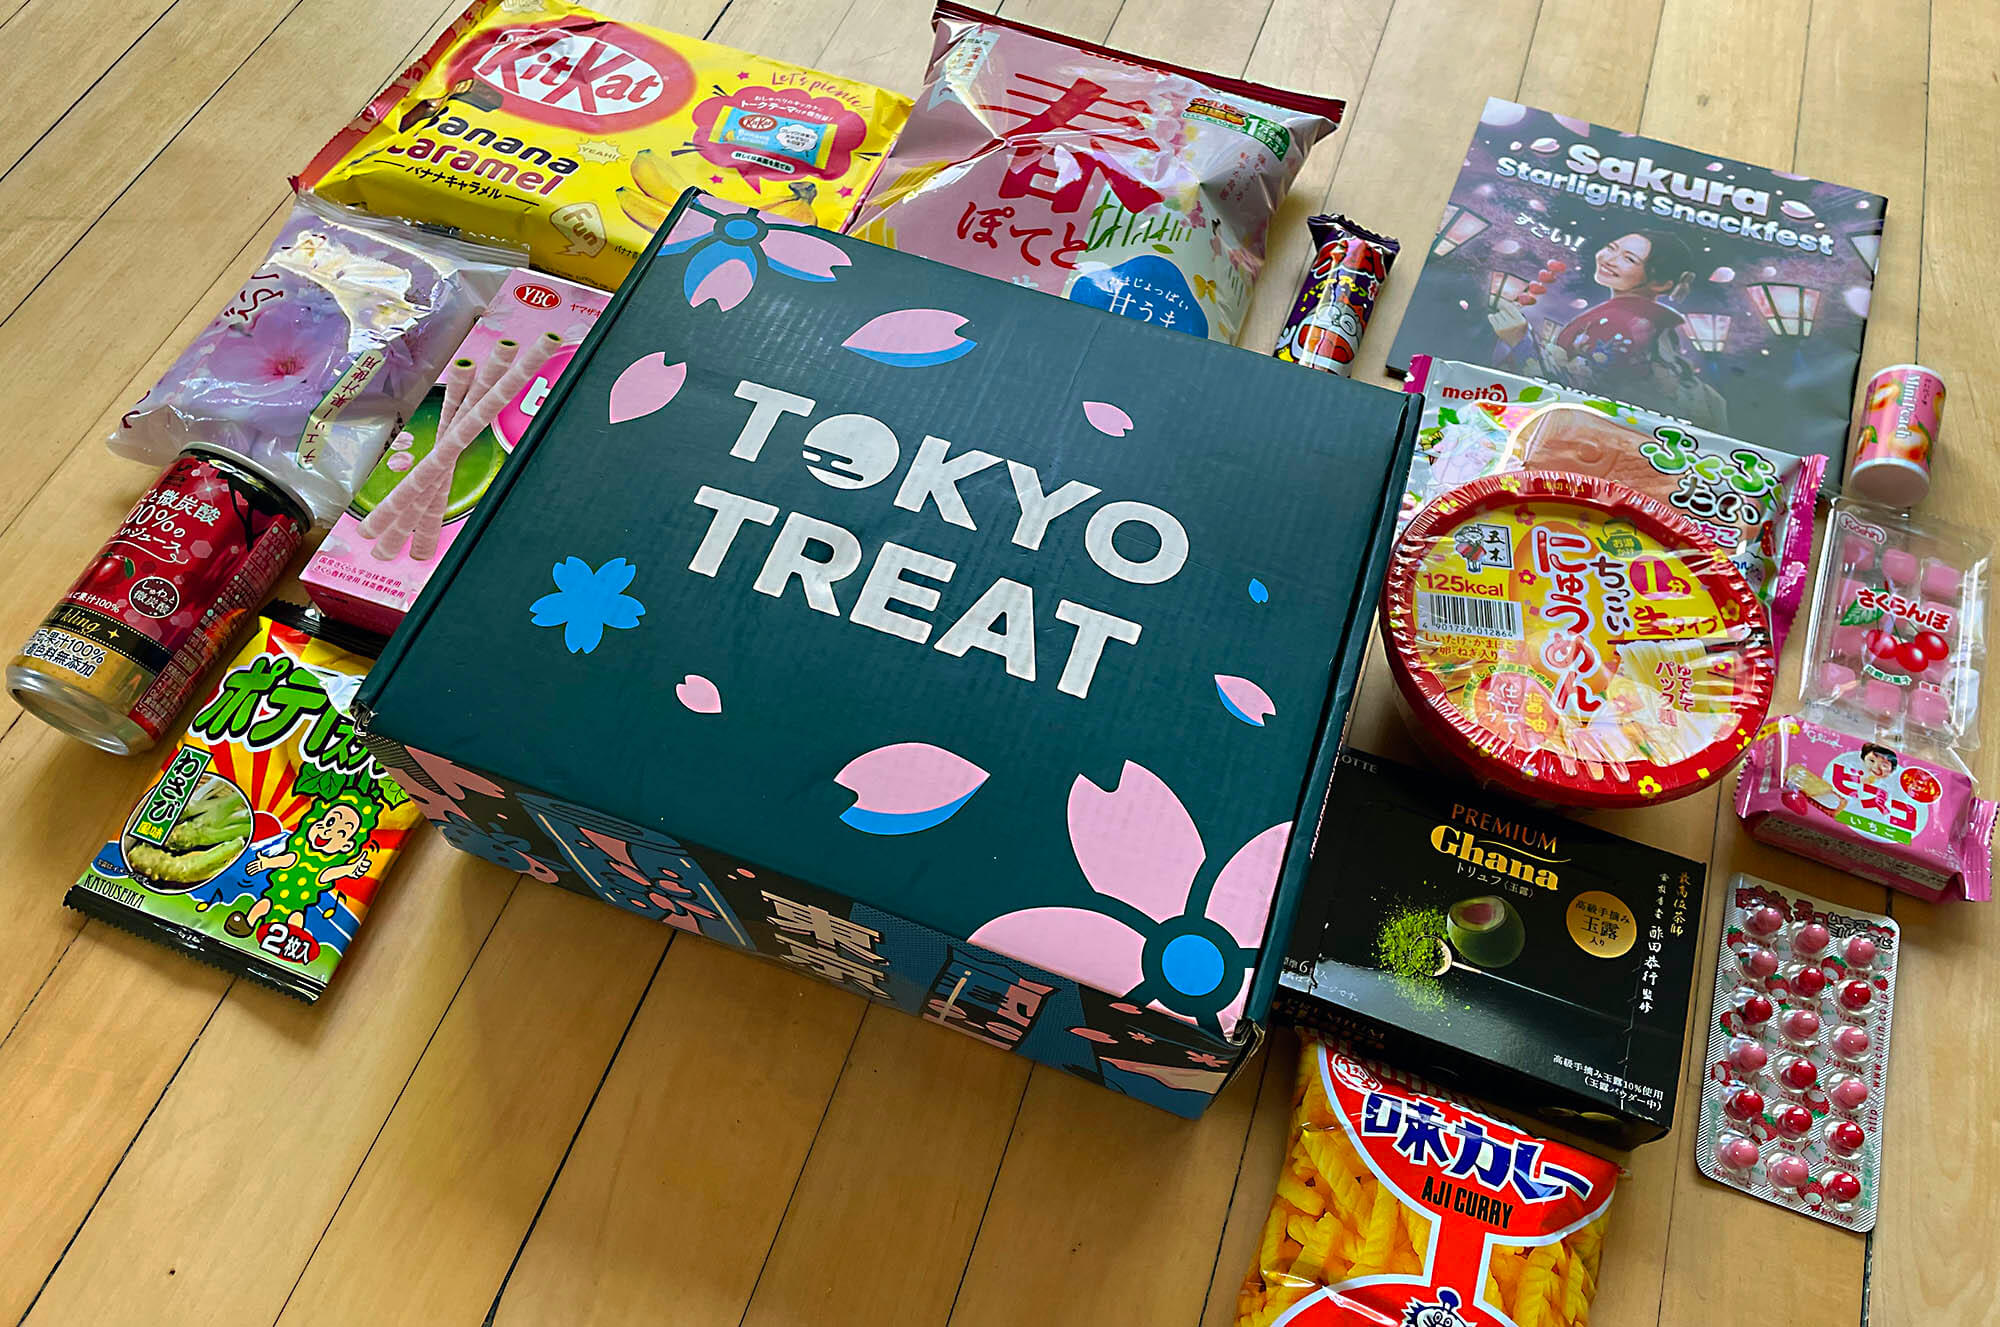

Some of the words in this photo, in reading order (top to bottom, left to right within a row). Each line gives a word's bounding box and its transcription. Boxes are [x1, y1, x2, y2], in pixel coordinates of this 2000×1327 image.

[477, 33, 662, 114] KitKat
[979, 73, 1166, 214] 春
[406, 165, 502, 199] バナナキャラメル
[1496, 156, 1649, 212] Starlight
[1651, 195, 1836, 257] Snackfest
[1566, 143, 1771, 217] Sakura
[563, 207, 598, 247] Fun
[957, 200, 1090, 270] ぽてと
[524, 287, 557, 308] YBC
[1442, 384, 1508, 403] meito
[729, 379, 1190, 584] TOKYO
[1670, 474, 1760, 524] たい
[688, 485, 1143, 699] TREAT
[1423, 573, 1504, 597] 125kcal
[1589, 556, 1631, 632] ちっこい
[1857, 588, 1951, 632] さくらんぼ
[1538, 529, 1602, 713] にゅうめん
[149, 751, 201, 823] わさび
[1341, 754, 1377, 774] OTTE
[1451, 803, 1558, 855] PREMIUM
[1849, 816, 1898, 839] いちご
[1431, 825, 1559, 891] Ghana
[83, 873, 146, 909] KATOUSEIKA
[261, 923, 311, 966] 2枚入
[1581, 914, 1621, 941] 玉露
[1362, 1091, 1594, 1204] 味カレー
[1421, 1174, 1452, 1209] AJI
[1455, 1185, 1514, 1230] CURRY
